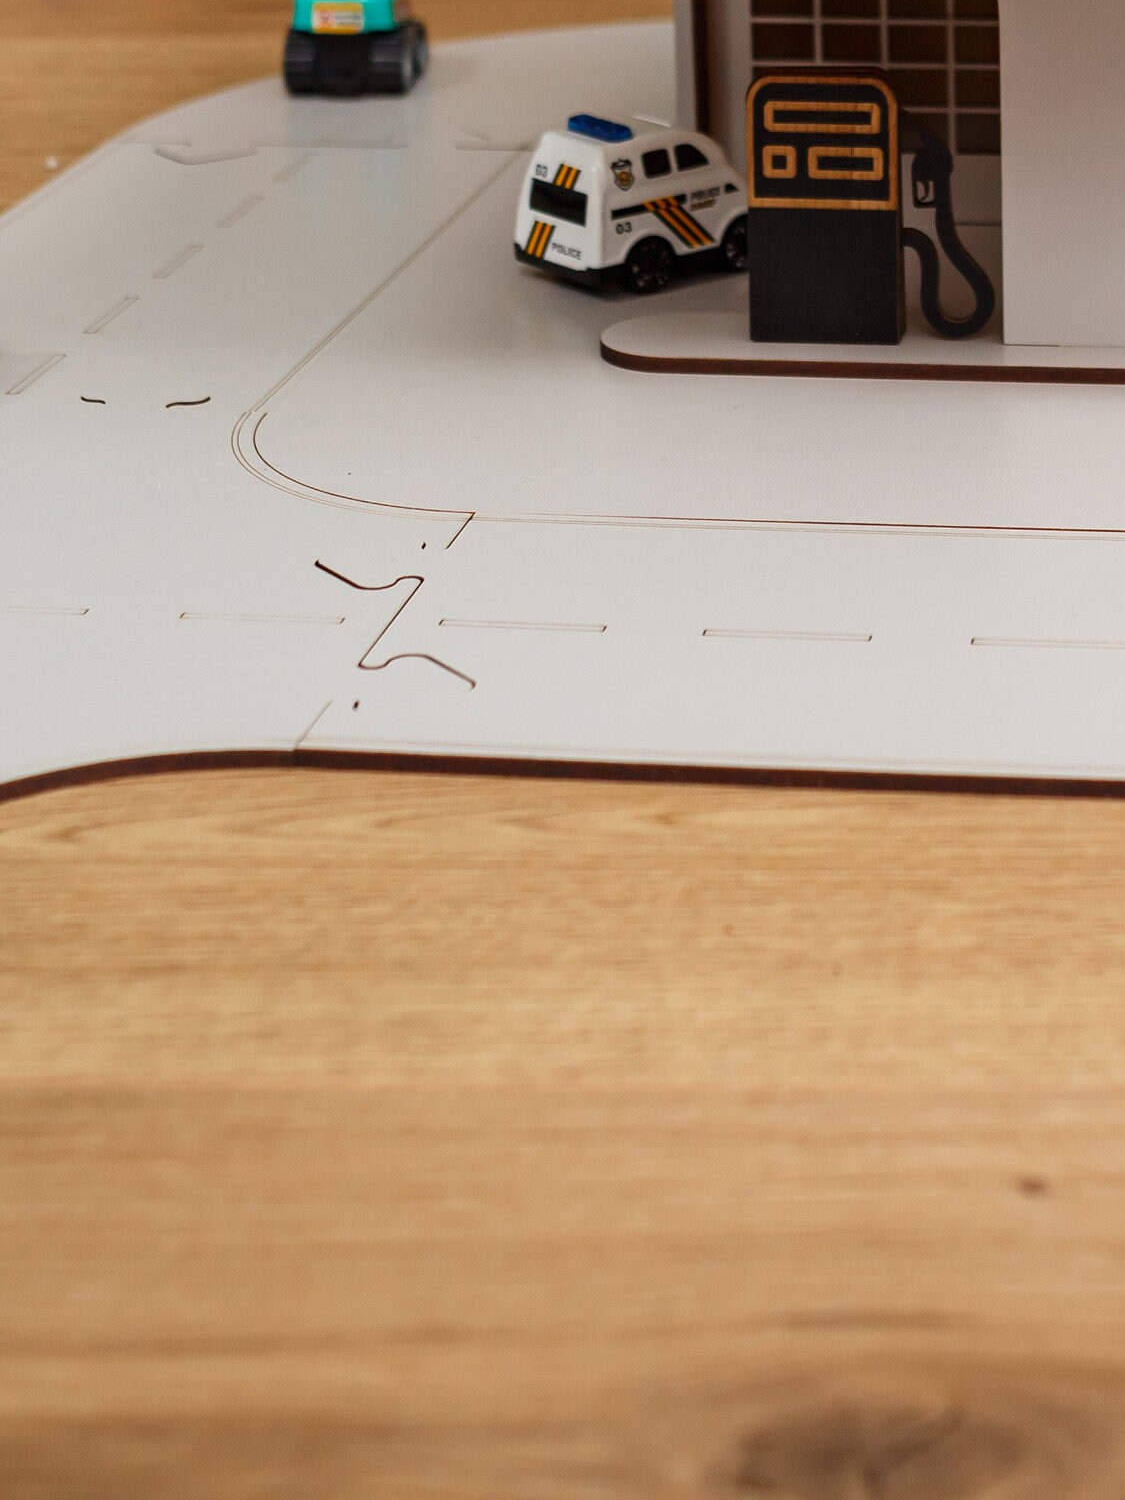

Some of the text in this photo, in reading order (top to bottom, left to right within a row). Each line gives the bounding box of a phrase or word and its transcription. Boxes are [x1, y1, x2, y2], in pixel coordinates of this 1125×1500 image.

[535, 163, 548, 178] 03
[615, 221, 632, 235] 03
[551, 242, 583, 261] POLICE
